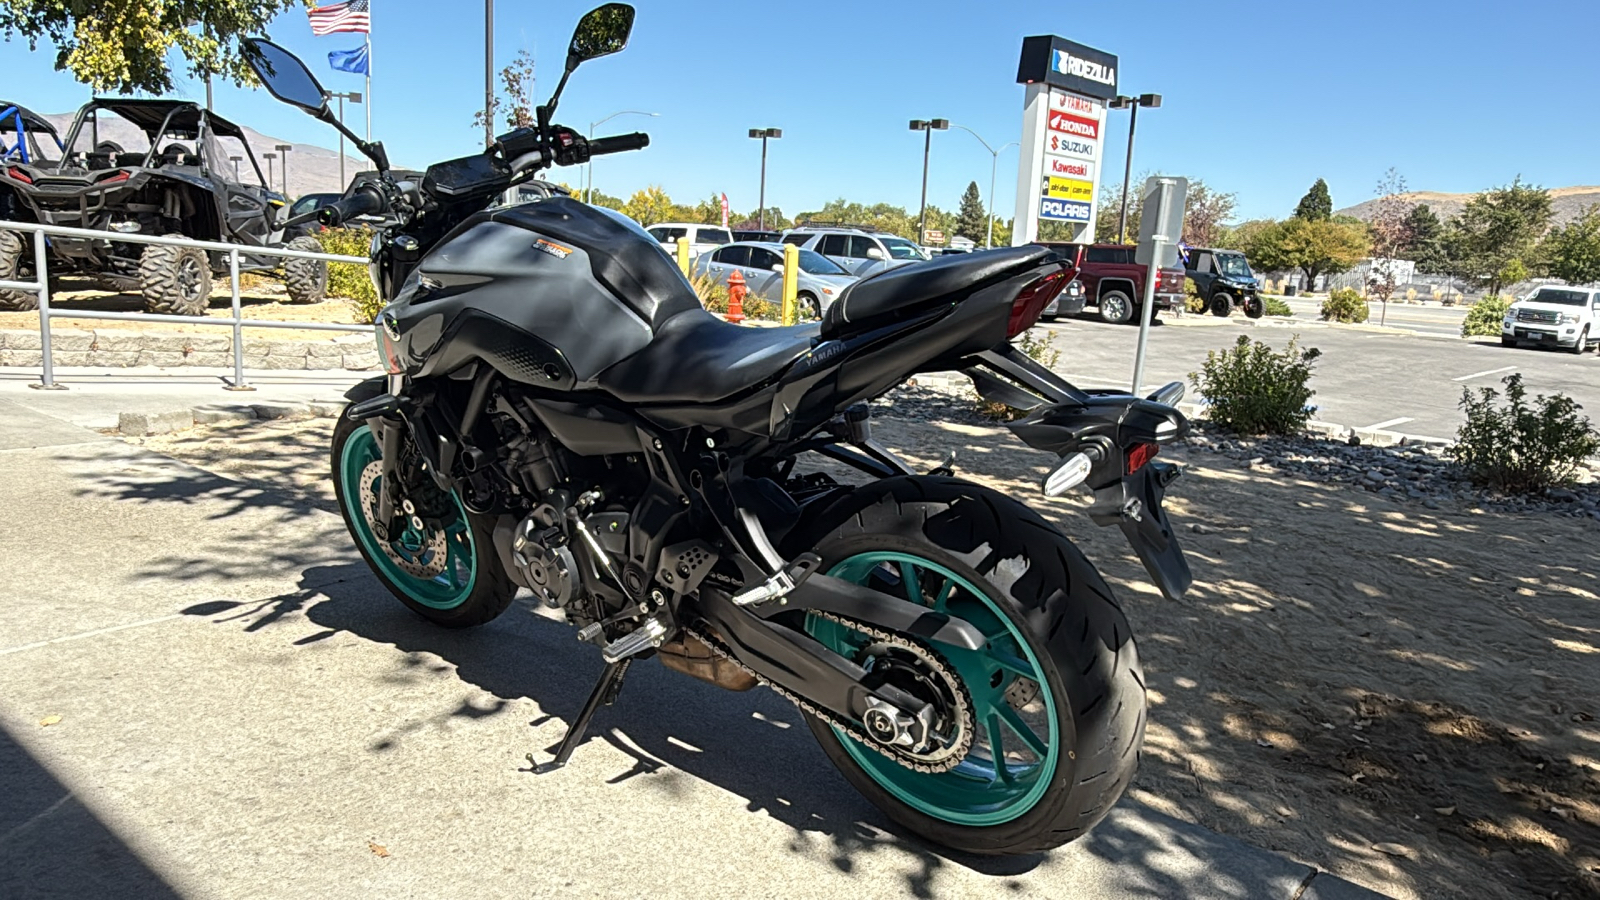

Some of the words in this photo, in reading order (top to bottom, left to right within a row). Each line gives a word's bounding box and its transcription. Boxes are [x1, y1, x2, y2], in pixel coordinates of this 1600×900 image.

[1068, 56, 1115, 86] RIDEZILLA
[1067, 94, 1092, 113] YAMAHA
[1060, 119, 1095, 137] HONDA
[1061, 140, 1092, 155] SUZUKI
[1052, 159, 1087, 176] Kawasaki
[1042, 202, 1089, 218] POLARIS
[806, 342, 847, 366] YAMAHA
